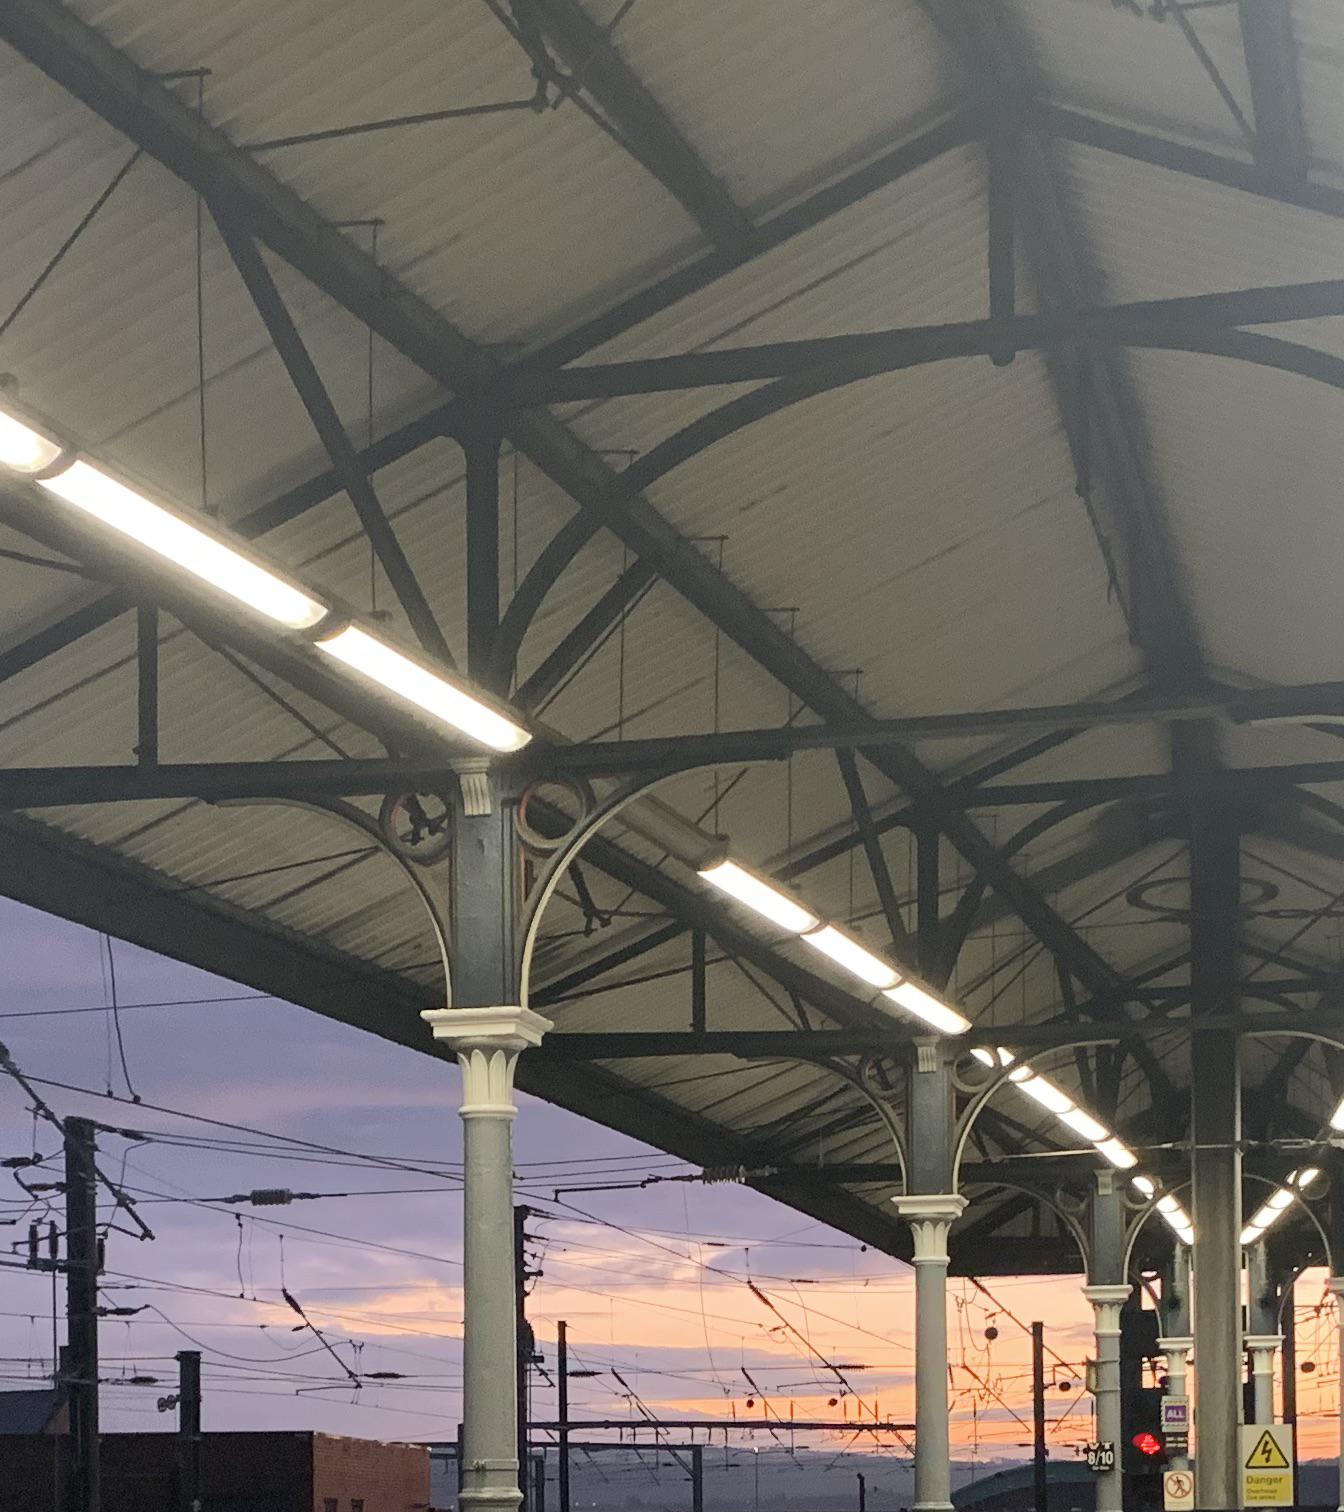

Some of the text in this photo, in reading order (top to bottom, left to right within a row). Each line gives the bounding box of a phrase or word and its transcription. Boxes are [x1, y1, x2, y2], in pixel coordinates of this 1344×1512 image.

[1167, 1409, 1186, 1420] ALL
[1087, 1450, 1114, 1466] 8/10
[1246, 1476, 1284, 1486] Danger
